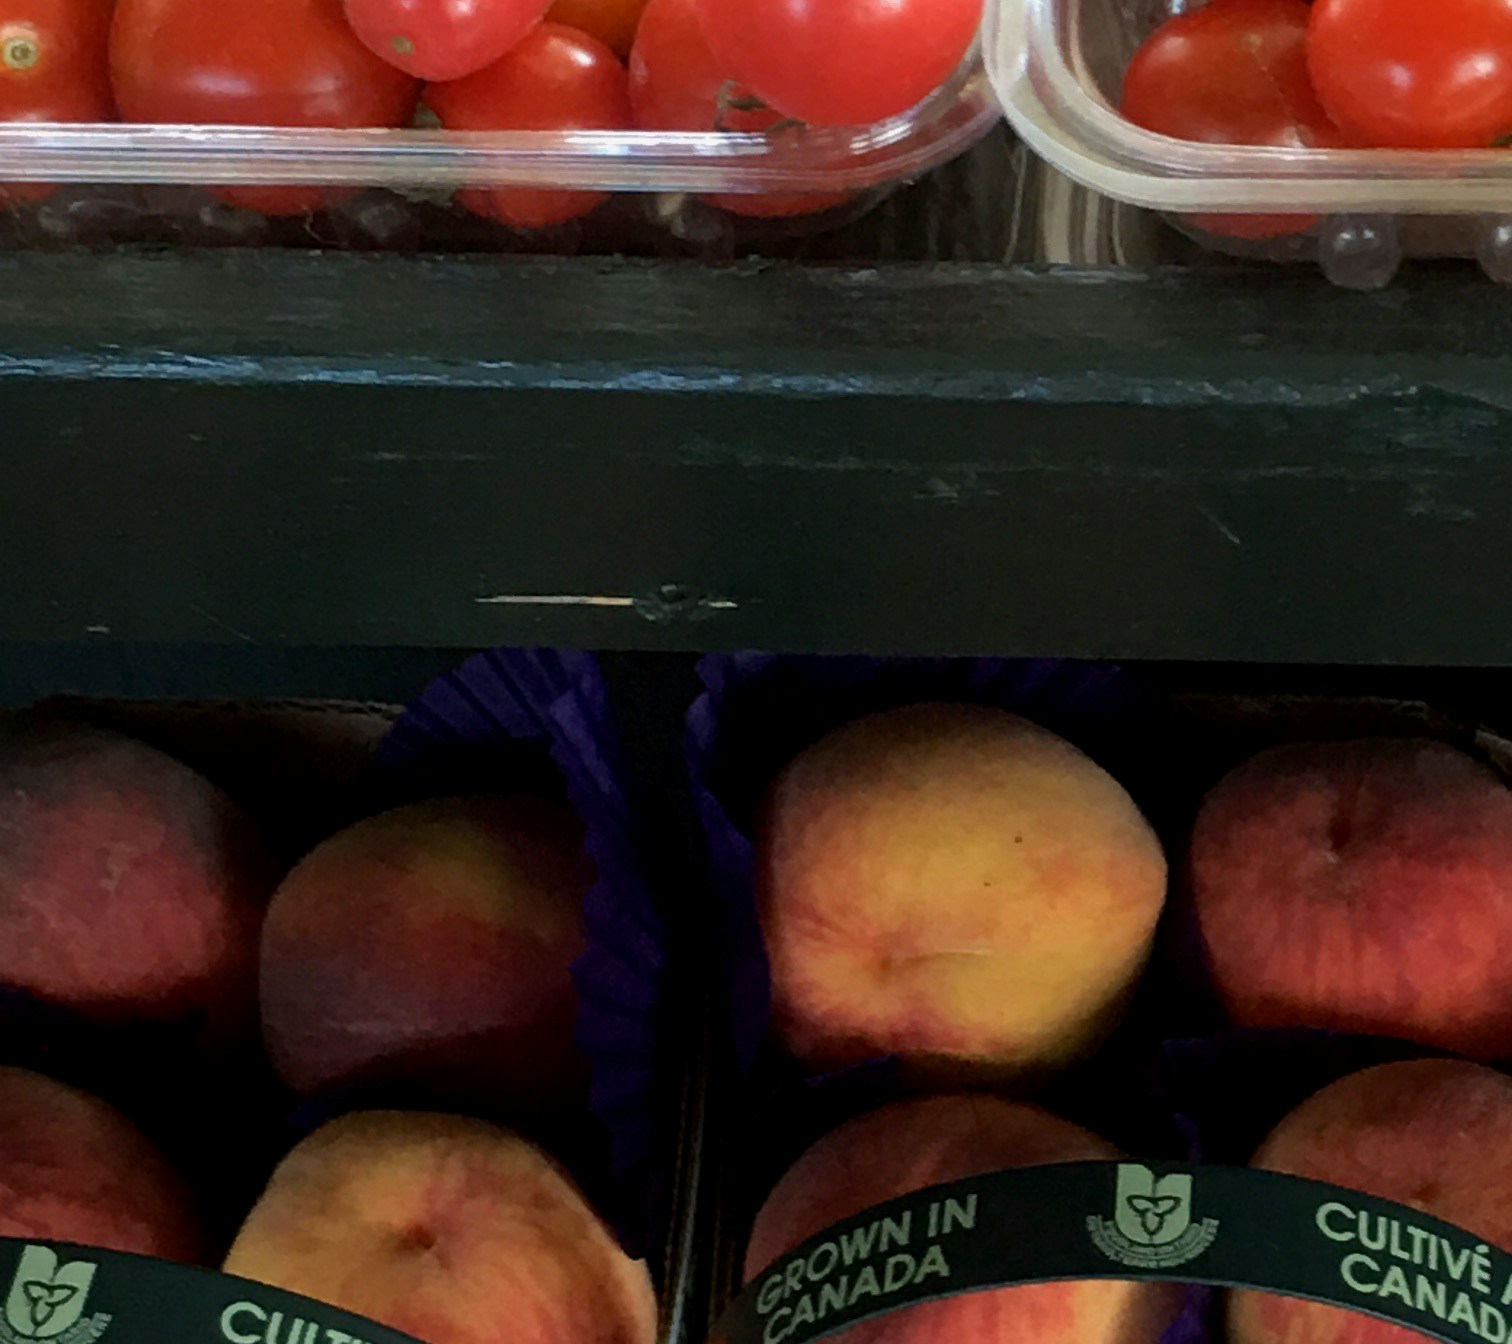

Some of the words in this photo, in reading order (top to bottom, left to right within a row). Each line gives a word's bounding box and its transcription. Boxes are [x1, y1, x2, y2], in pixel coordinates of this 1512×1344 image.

[756, 1210, 912, 1315] GROWN
[926, 1193, 979, 1240] IN
[1315, 1201, 1492, 1295] CULTIVÉ
